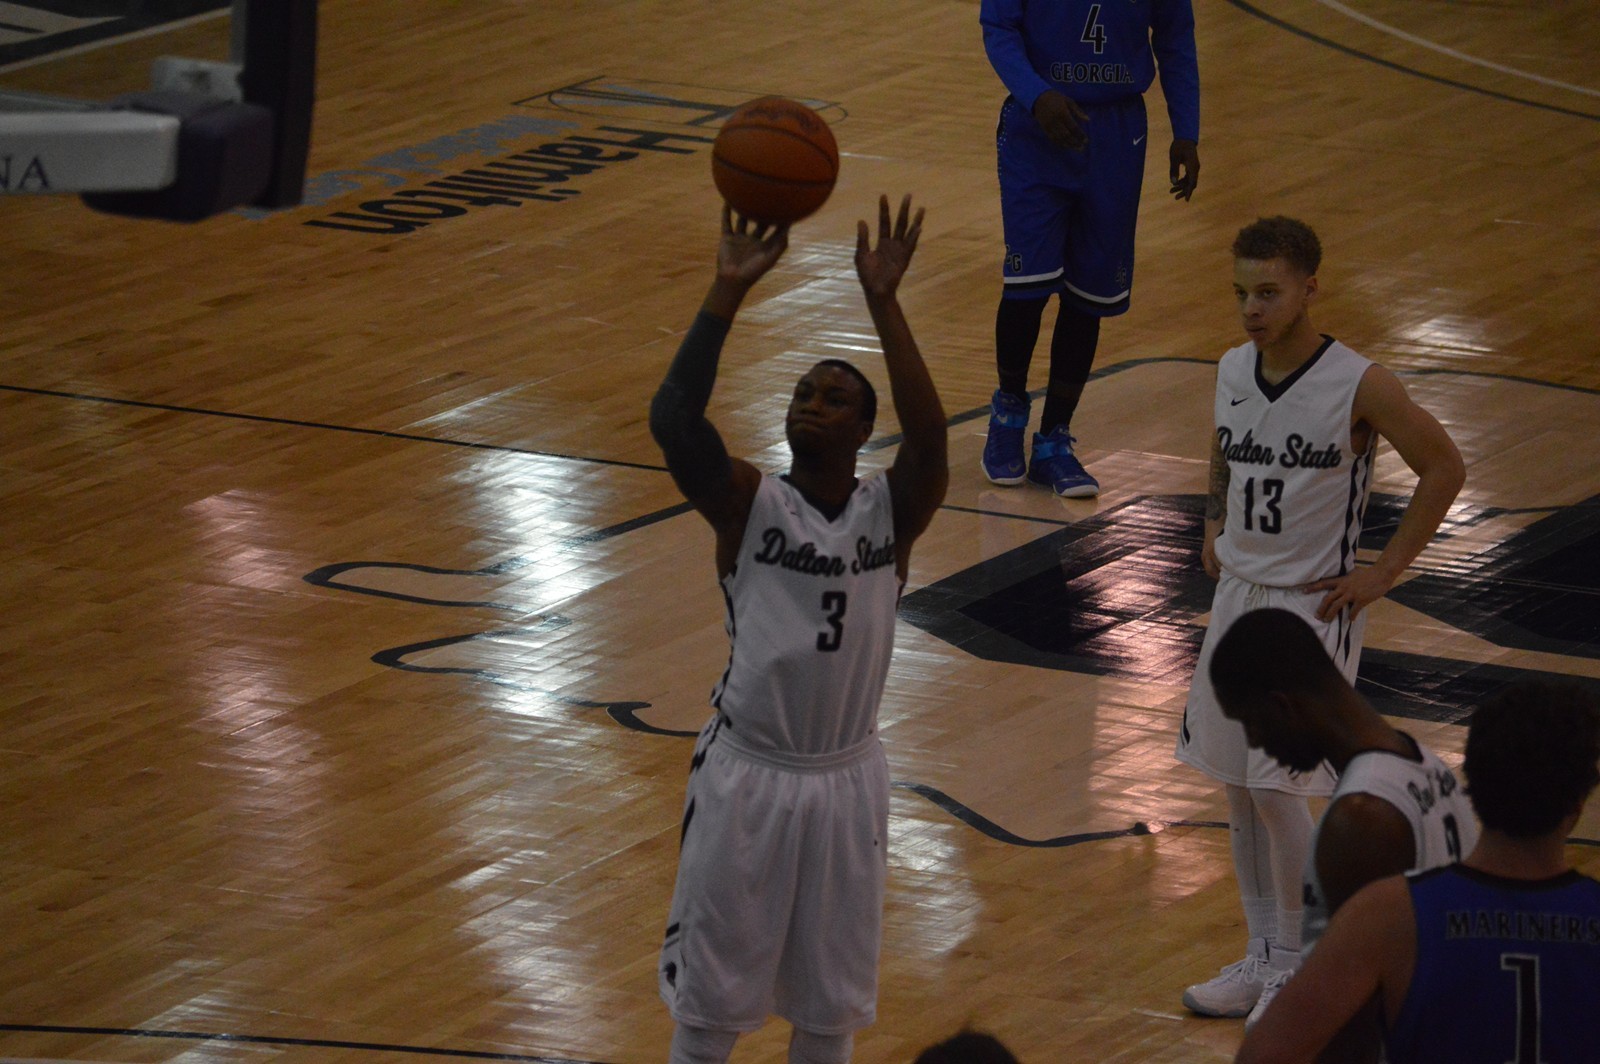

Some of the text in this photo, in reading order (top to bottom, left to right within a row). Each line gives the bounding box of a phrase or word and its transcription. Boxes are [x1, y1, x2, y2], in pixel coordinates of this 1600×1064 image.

[1080, 3, 1107, 55] 4
[1050, 62, 1135, 84] GEORGIA
[1279, 433, 1342, 469] State
[1244, 476, 1285, 535] 13
[754, 527, 846, 578] Dalton
[816, 591, 847, 652] 3
[1445, 910, 1600, 946] MARINERS
[1500, 952, 1550, 1064] 1
